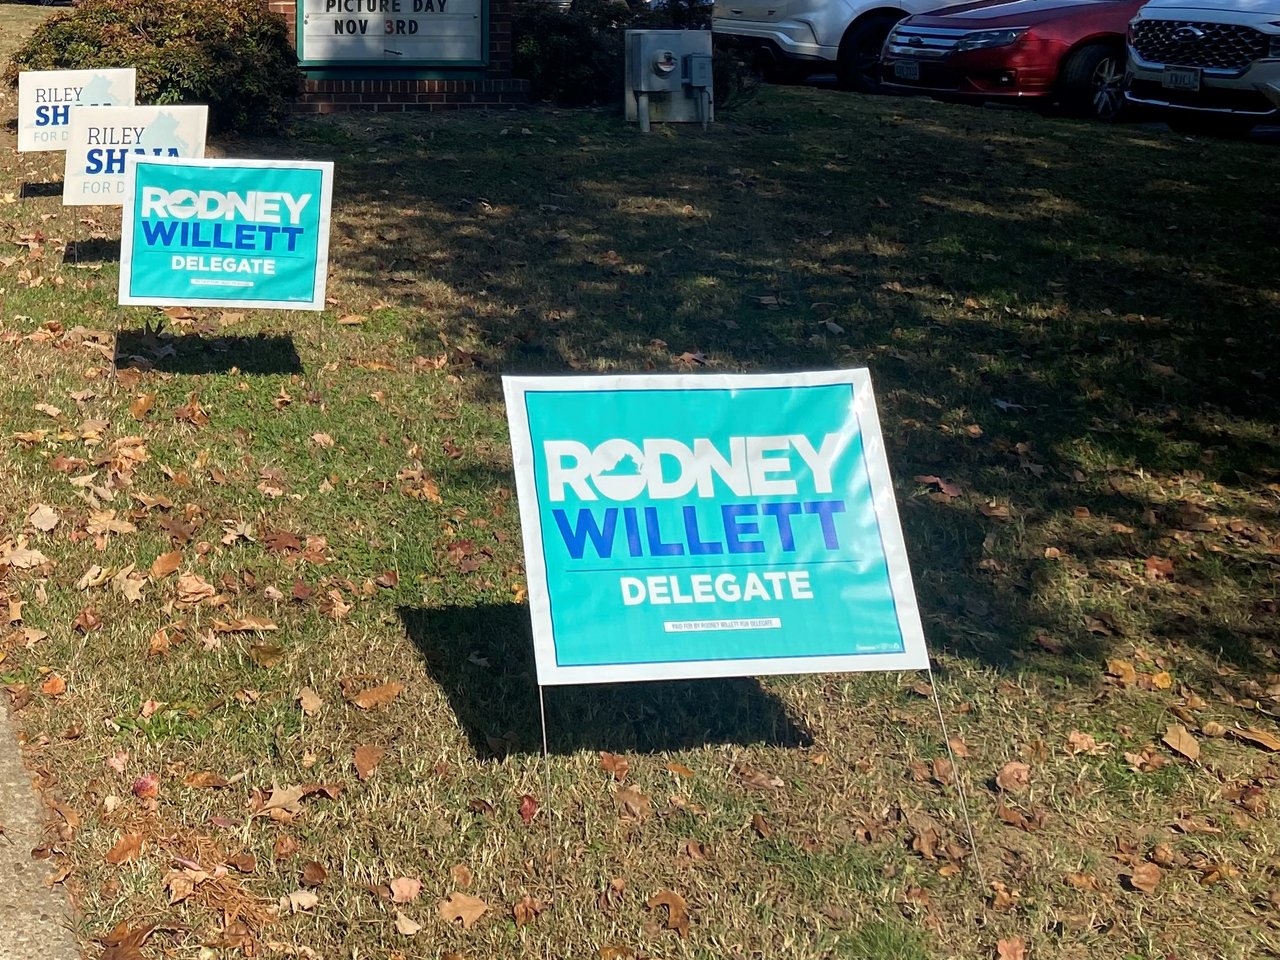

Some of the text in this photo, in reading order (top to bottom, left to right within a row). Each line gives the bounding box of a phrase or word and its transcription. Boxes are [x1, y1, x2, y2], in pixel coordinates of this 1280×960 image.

[334, 19, 418, 35] NOV 3RD
[36, 87, 84, 103] RILEY
[34, 131, 57, 142] FOR
[87, 127, 145, 145] RILEY
[82, 181, 111, 194] FOR
[141, 186, 312, 225] RODNEY
[142, 221, 304, 252] WILLETT
[172, 256, 276, 275] DELEGATE
[543, 433, 842, 502] RODNEY
[551, 500, 846, 560] WILLETT
[620, 571, 814, 606] DELEGATE
